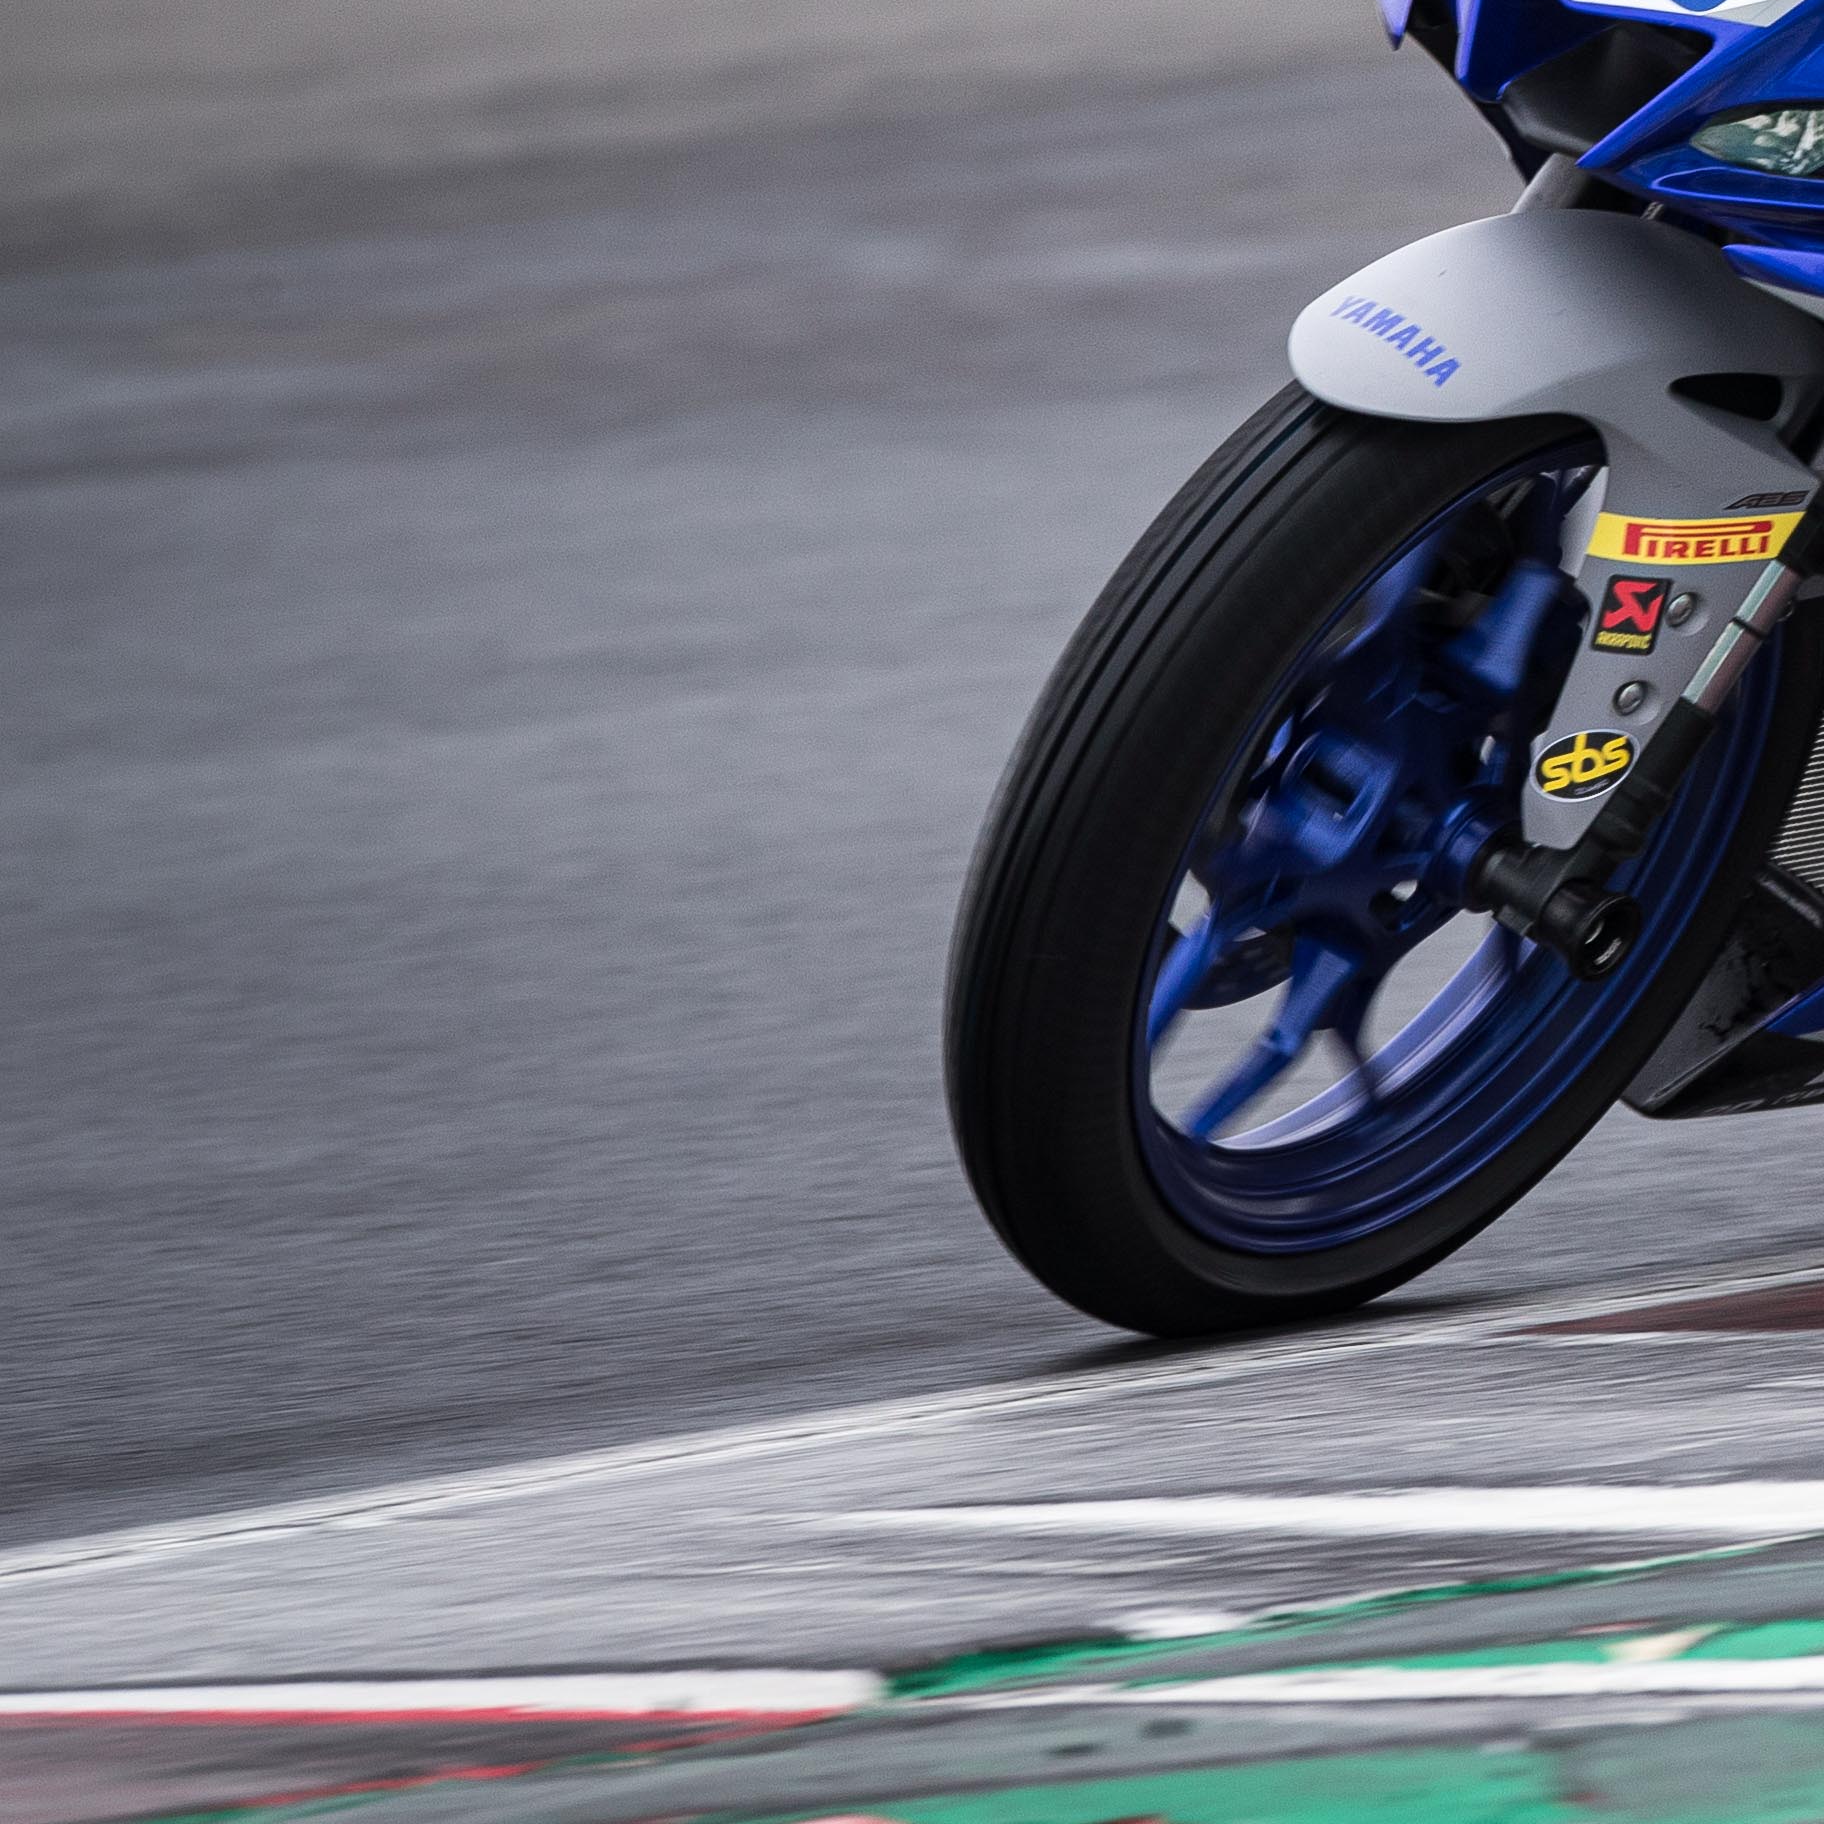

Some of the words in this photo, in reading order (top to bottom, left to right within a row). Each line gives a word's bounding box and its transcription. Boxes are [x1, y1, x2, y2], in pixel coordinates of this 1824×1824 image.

[1330, 295, 1460, 389] YAMAHA
[1621, 520, 1774, 559] PIRELLI
[1541, 733, 1630, 793] sbs
